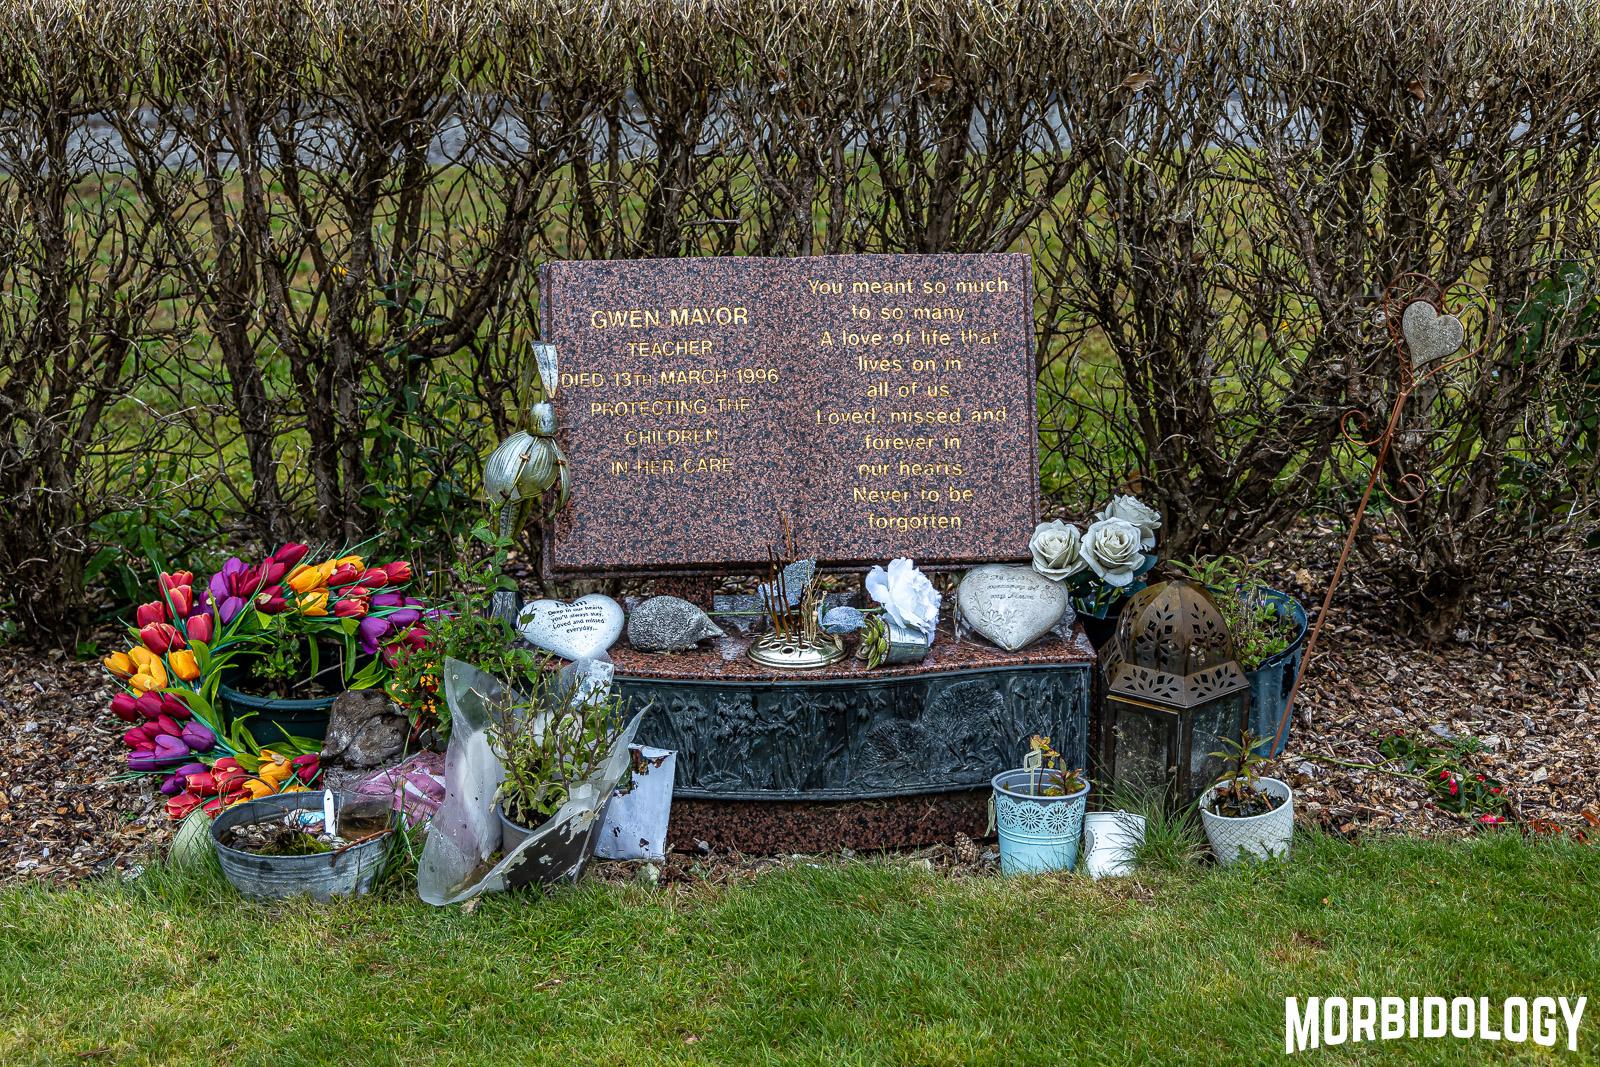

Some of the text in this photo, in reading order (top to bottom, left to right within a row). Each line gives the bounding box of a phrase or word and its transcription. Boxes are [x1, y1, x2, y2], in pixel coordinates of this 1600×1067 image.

[808, 277, 1009, 295] You meant so much
[591, 307, 748, 329] GWEN MAYOR
[852, 305, 965, 323] to so many
[820, 330, 999, 346] A love of life that
[628, 341, 713, 357] TEACHER
[858, 356, 962, 372] lives on in
[561, 373, 604, 388] DIED
[661, 369, 726, 385] MARCH
[736, 368, 780, 384] 1996
[866, 382, 949, 397] all of us
[591, 399, 750, 416] PROTECTING THE
[891, 408, 961, 424] missed
[971, 407, 1007, 422] and
[625, 429, 719, 446] CHILDREN
[865, 435, 961, 450] forever in
[611, 458, 733, 475] IN HER CARE
[858, 463, 889, 476] our
[853, 487, 974, 503] Never to be
[868, 514, 962, 532] forgotten
